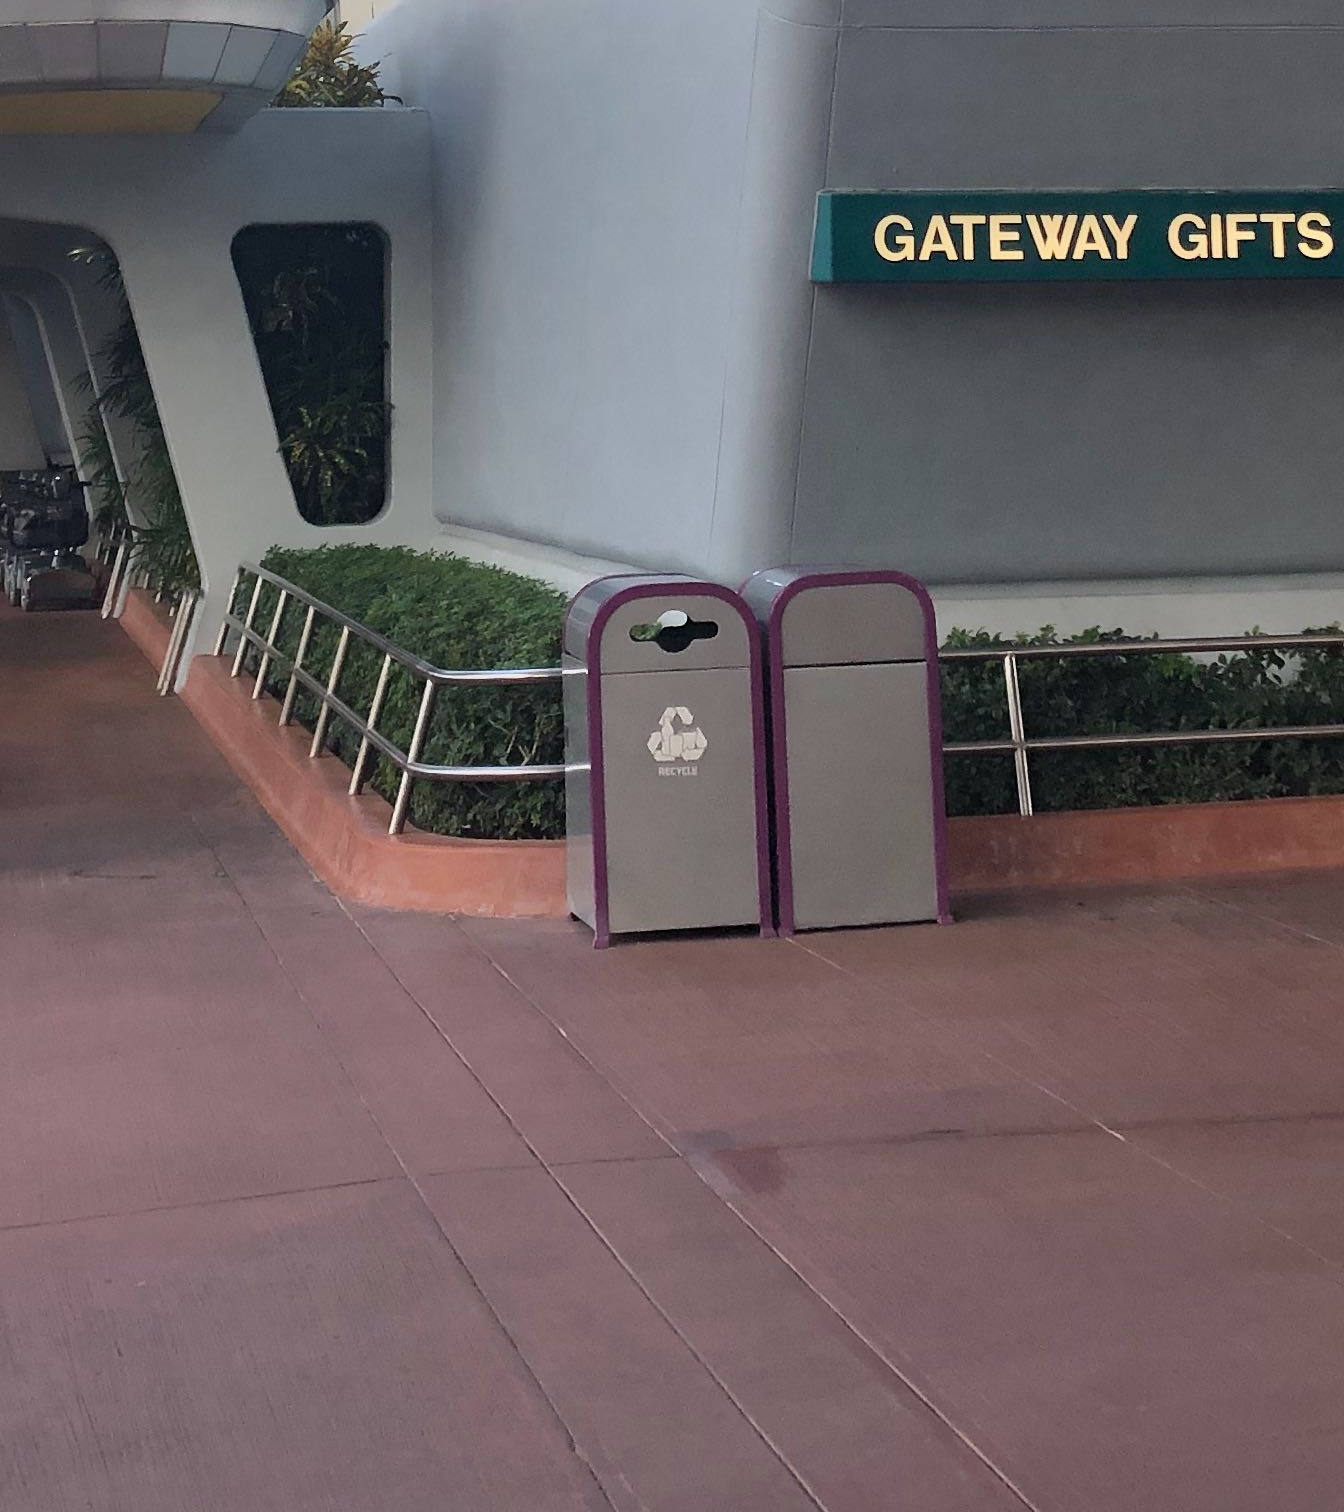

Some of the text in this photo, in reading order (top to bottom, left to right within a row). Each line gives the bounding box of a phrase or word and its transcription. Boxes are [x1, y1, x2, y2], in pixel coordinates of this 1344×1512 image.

[873, 212, 1335, 262] GATEWAY GIFTS
[658, 766, 698, 777] RECYCLE
